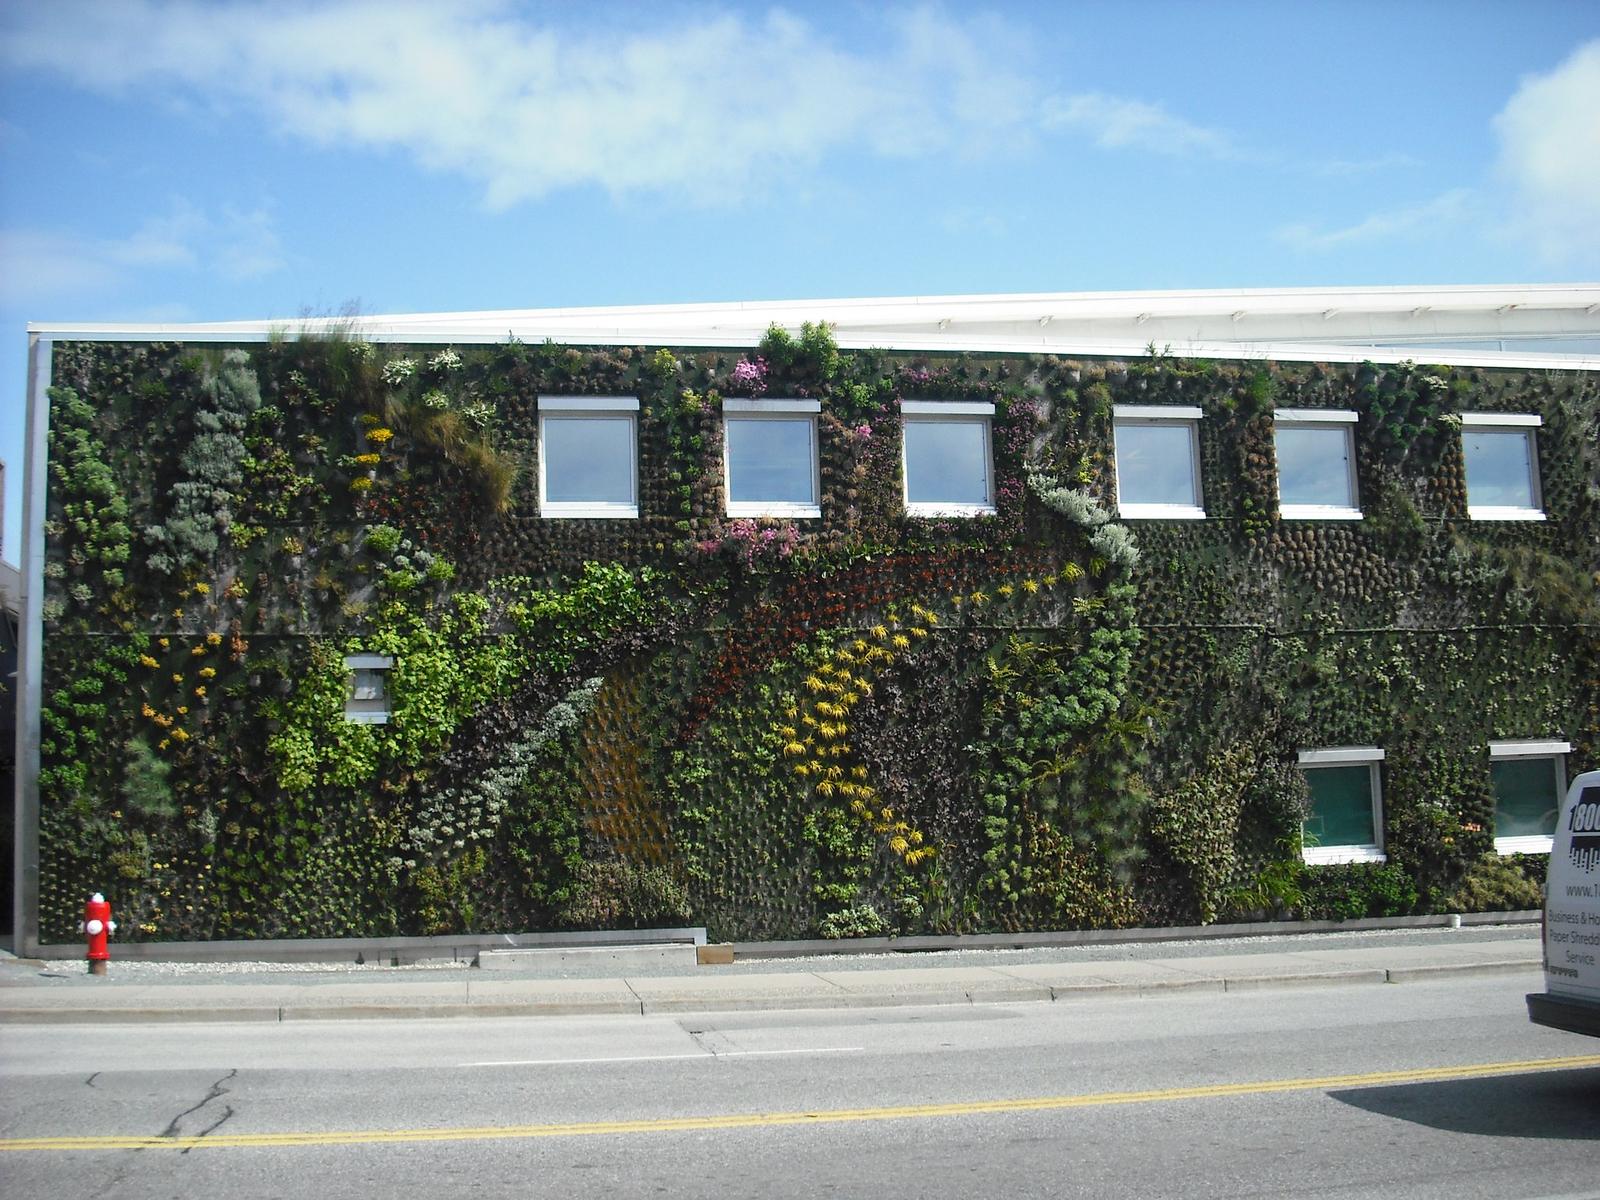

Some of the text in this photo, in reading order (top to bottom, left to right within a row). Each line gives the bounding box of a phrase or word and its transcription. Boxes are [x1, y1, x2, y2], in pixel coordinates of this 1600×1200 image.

[1580, 911, 1587, 925] &
[1550, 929, 1569, 944] Paper
[1566, 950, 1595, 966] Service
